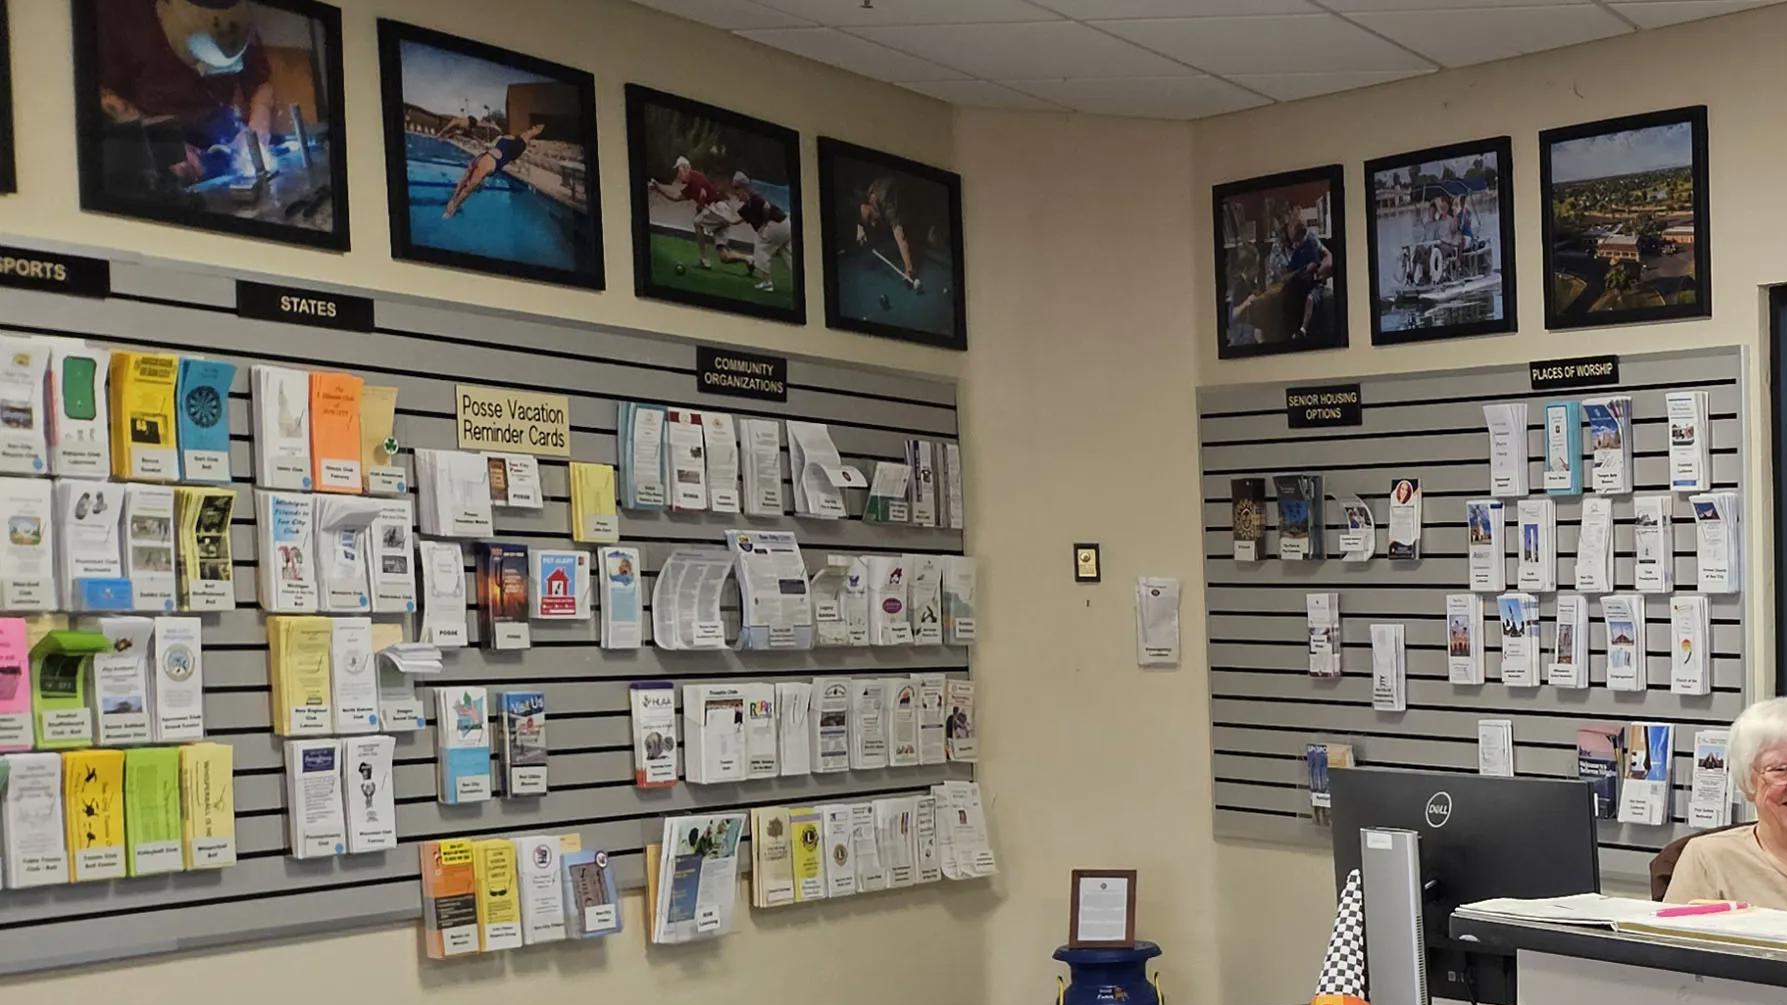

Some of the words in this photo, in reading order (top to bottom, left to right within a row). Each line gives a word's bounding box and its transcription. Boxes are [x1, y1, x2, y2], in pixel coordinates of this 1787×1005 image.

[280, 296, 337, 318] STATES
[714, 356, 774, 376] COMMUNITY
[1532, 367, 1563, 381] PLACES
[1564, 366, 1575, 378] OF
[1576, 362, 1613, 377] WORSHIP
[704, 374, 784, 394] ORGANIZATIONS
[1288, 393, 1319, 406] SENIOR
[1320, 391, 1358, 405] HOUSING
[462, 394, 503, 418] Posse
[507, 398, 564, 425] Vacation
[1305, 407, 1342, 421] OPTIONS
[463, 419, 524, 445] Reminder
[528, 424, 565, 448] Cards
[1428, 804, 1448, 816] DELL
